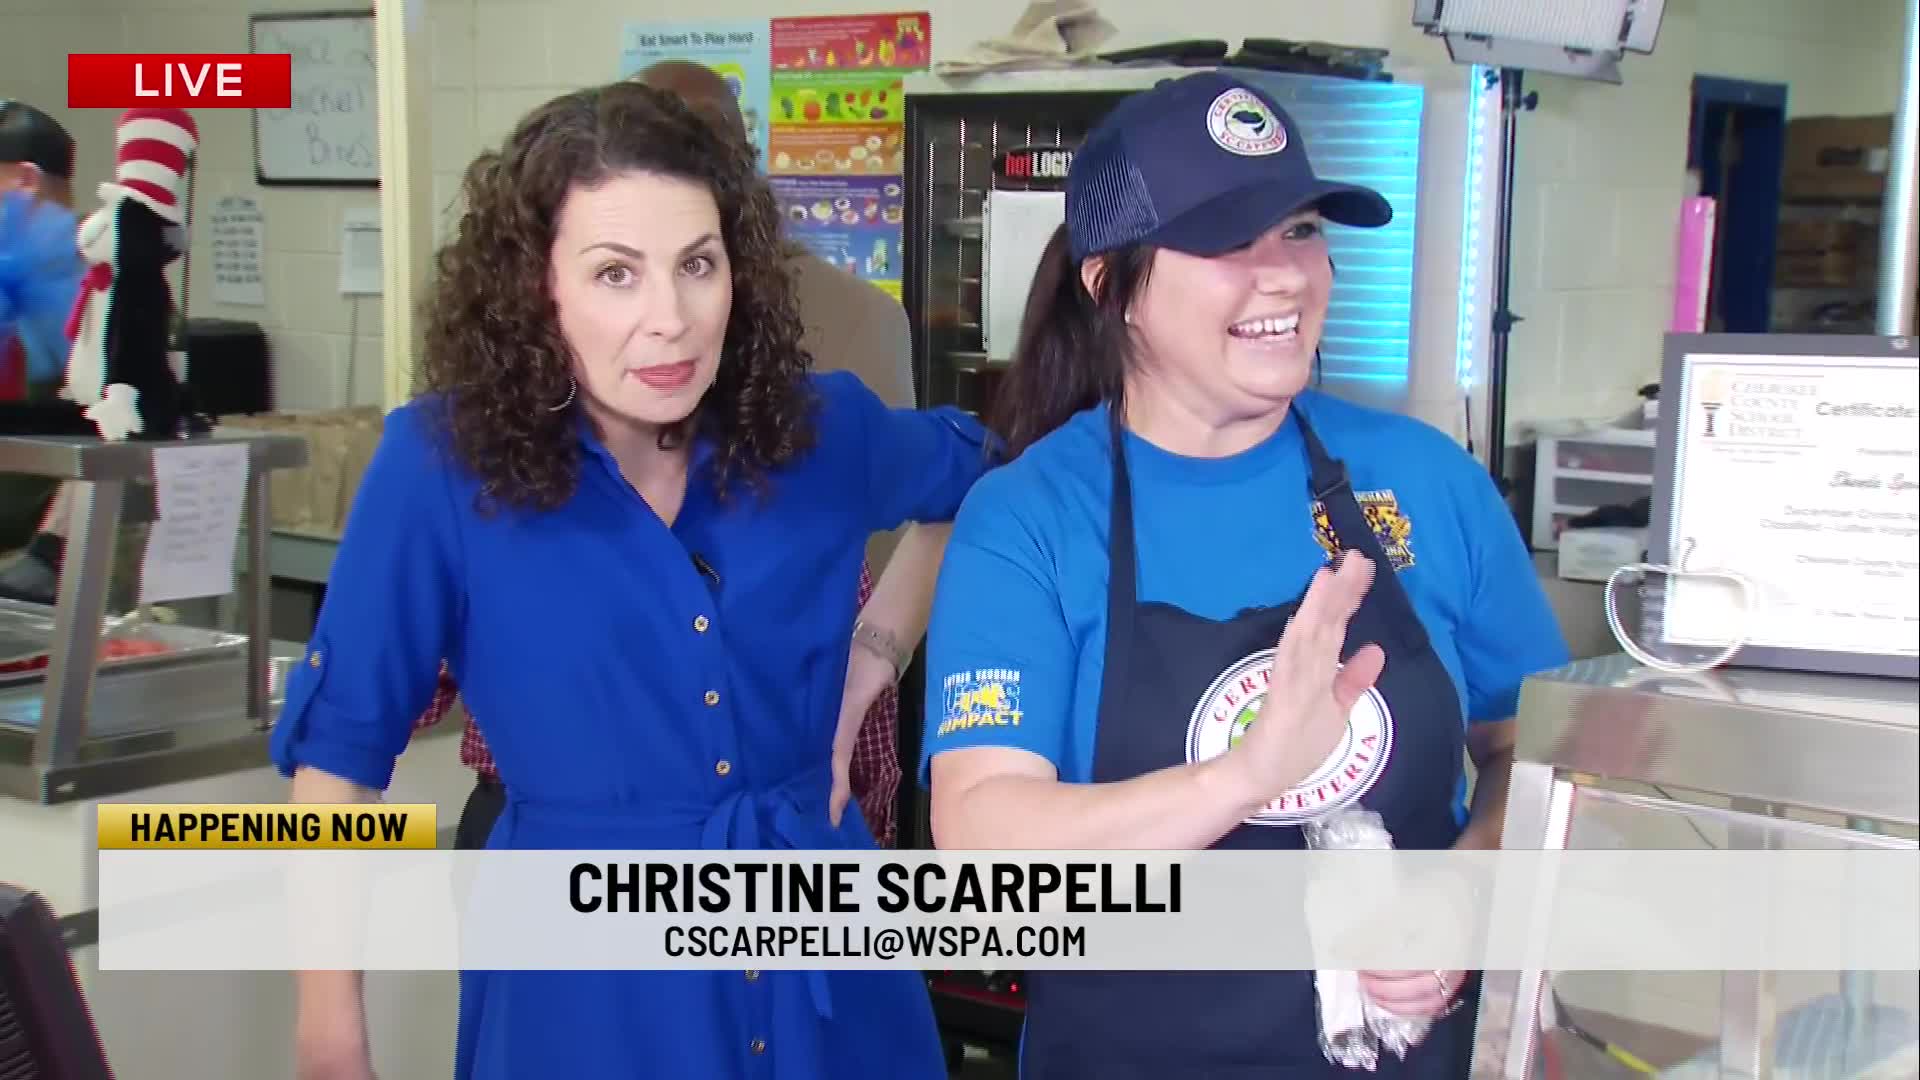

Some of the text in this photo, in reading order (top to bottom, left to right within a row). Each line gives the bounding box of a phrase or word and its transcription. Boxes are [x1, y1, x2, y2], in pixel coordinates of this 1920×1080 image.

[640, 31, 753, 46] Eat Smart To Play Hard
[1264, 734, 1377, 810] FETERIA
